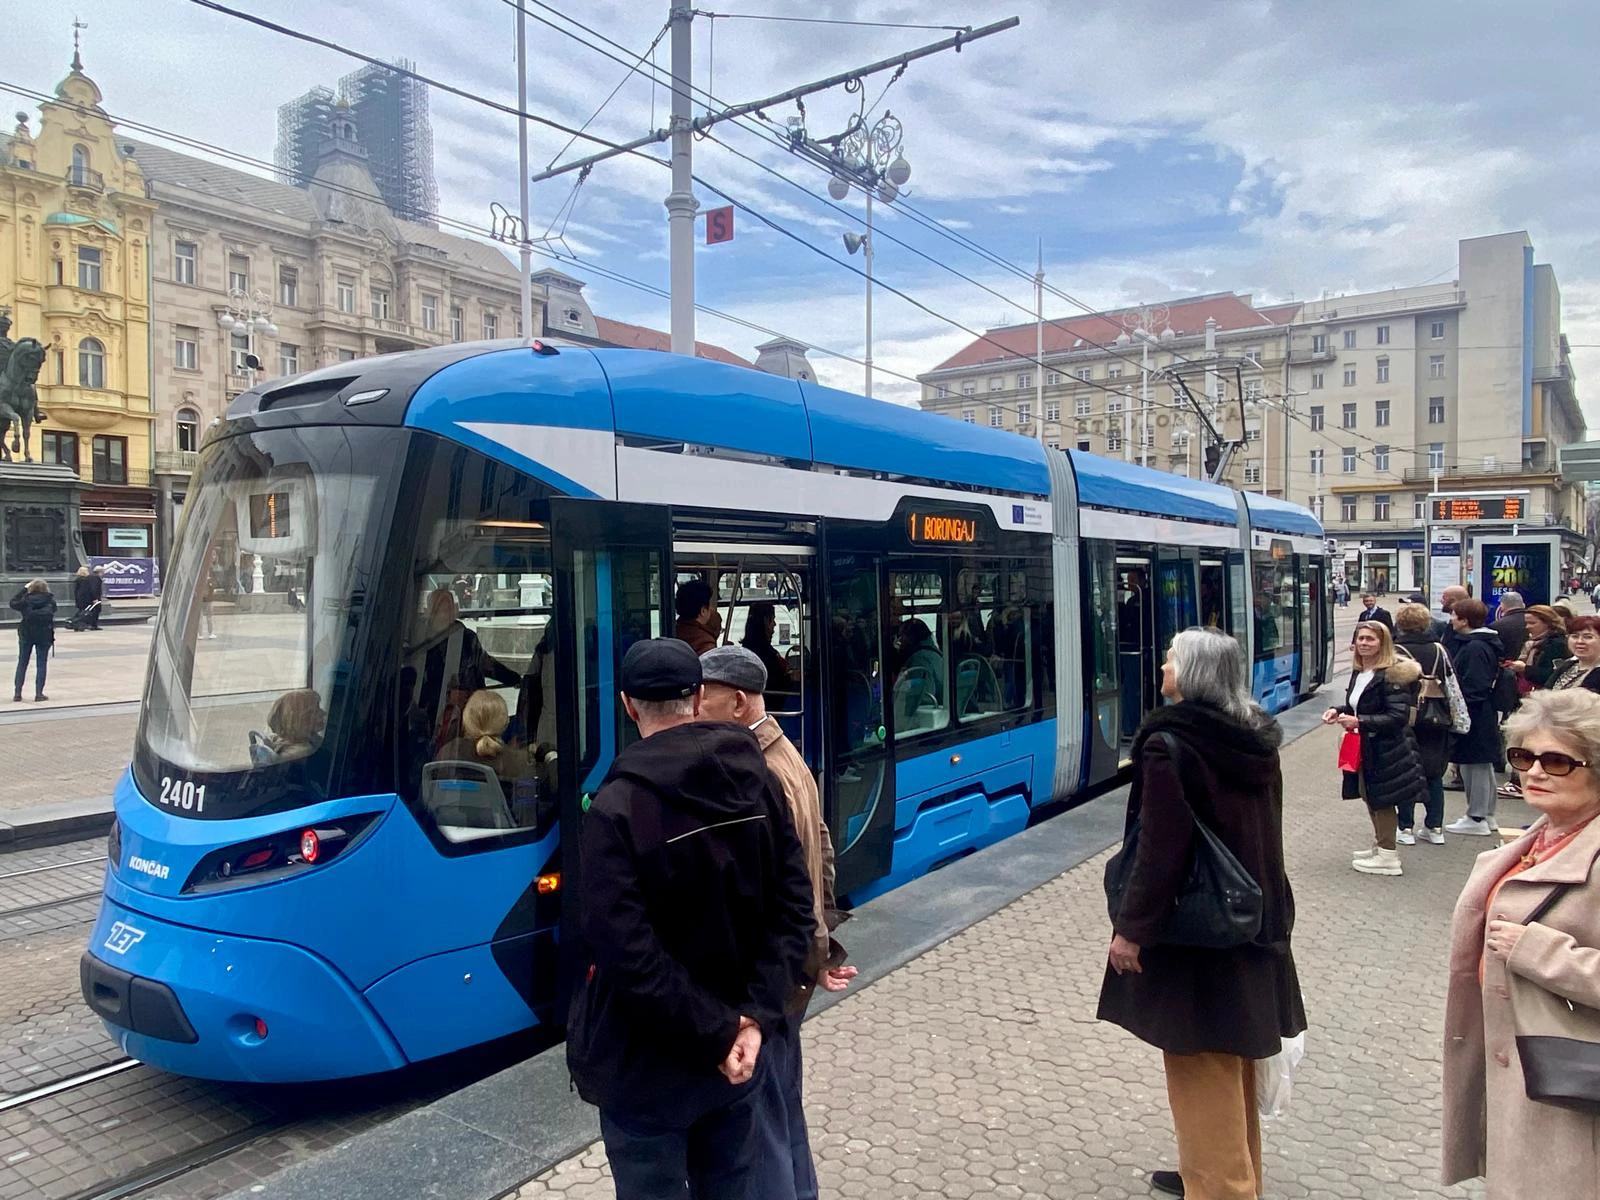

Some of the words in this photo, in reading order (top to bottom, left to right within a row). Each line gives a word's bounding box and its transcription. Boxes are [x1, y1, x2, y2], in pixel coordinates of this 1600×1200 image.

[713, 212, 725, 240] S
[910, 512, 917, 541] 1
[924, 516, 975, 542] BORONGAJ
[160, 776, 206, 812] 2401
[129, 856, 169, 879] KONČAR
